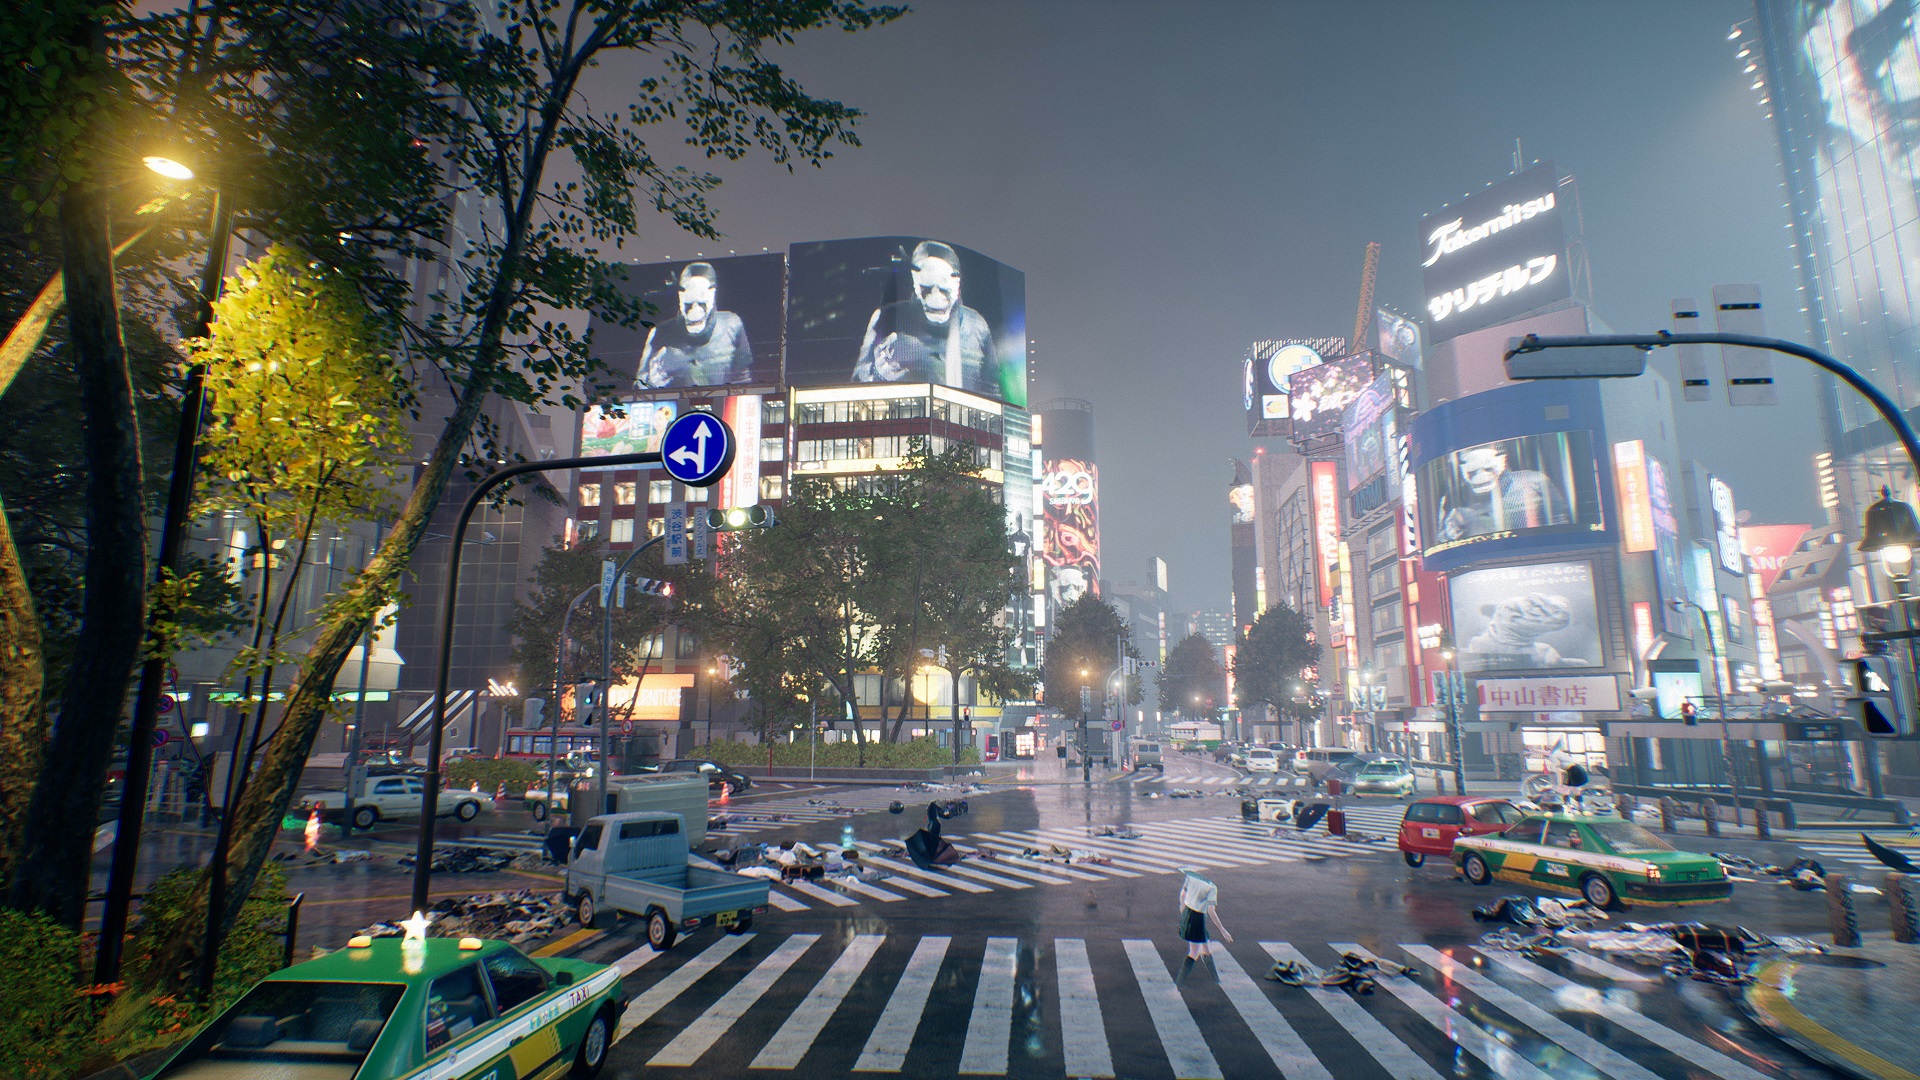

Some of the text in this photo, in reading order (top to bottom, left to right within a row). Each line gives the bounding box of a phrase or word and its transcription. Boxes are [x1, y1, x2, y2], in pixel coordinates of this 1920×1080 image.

[1490, 685, 1587, 706] 中山書店
[569, 985, 591, 1007] TAXI
